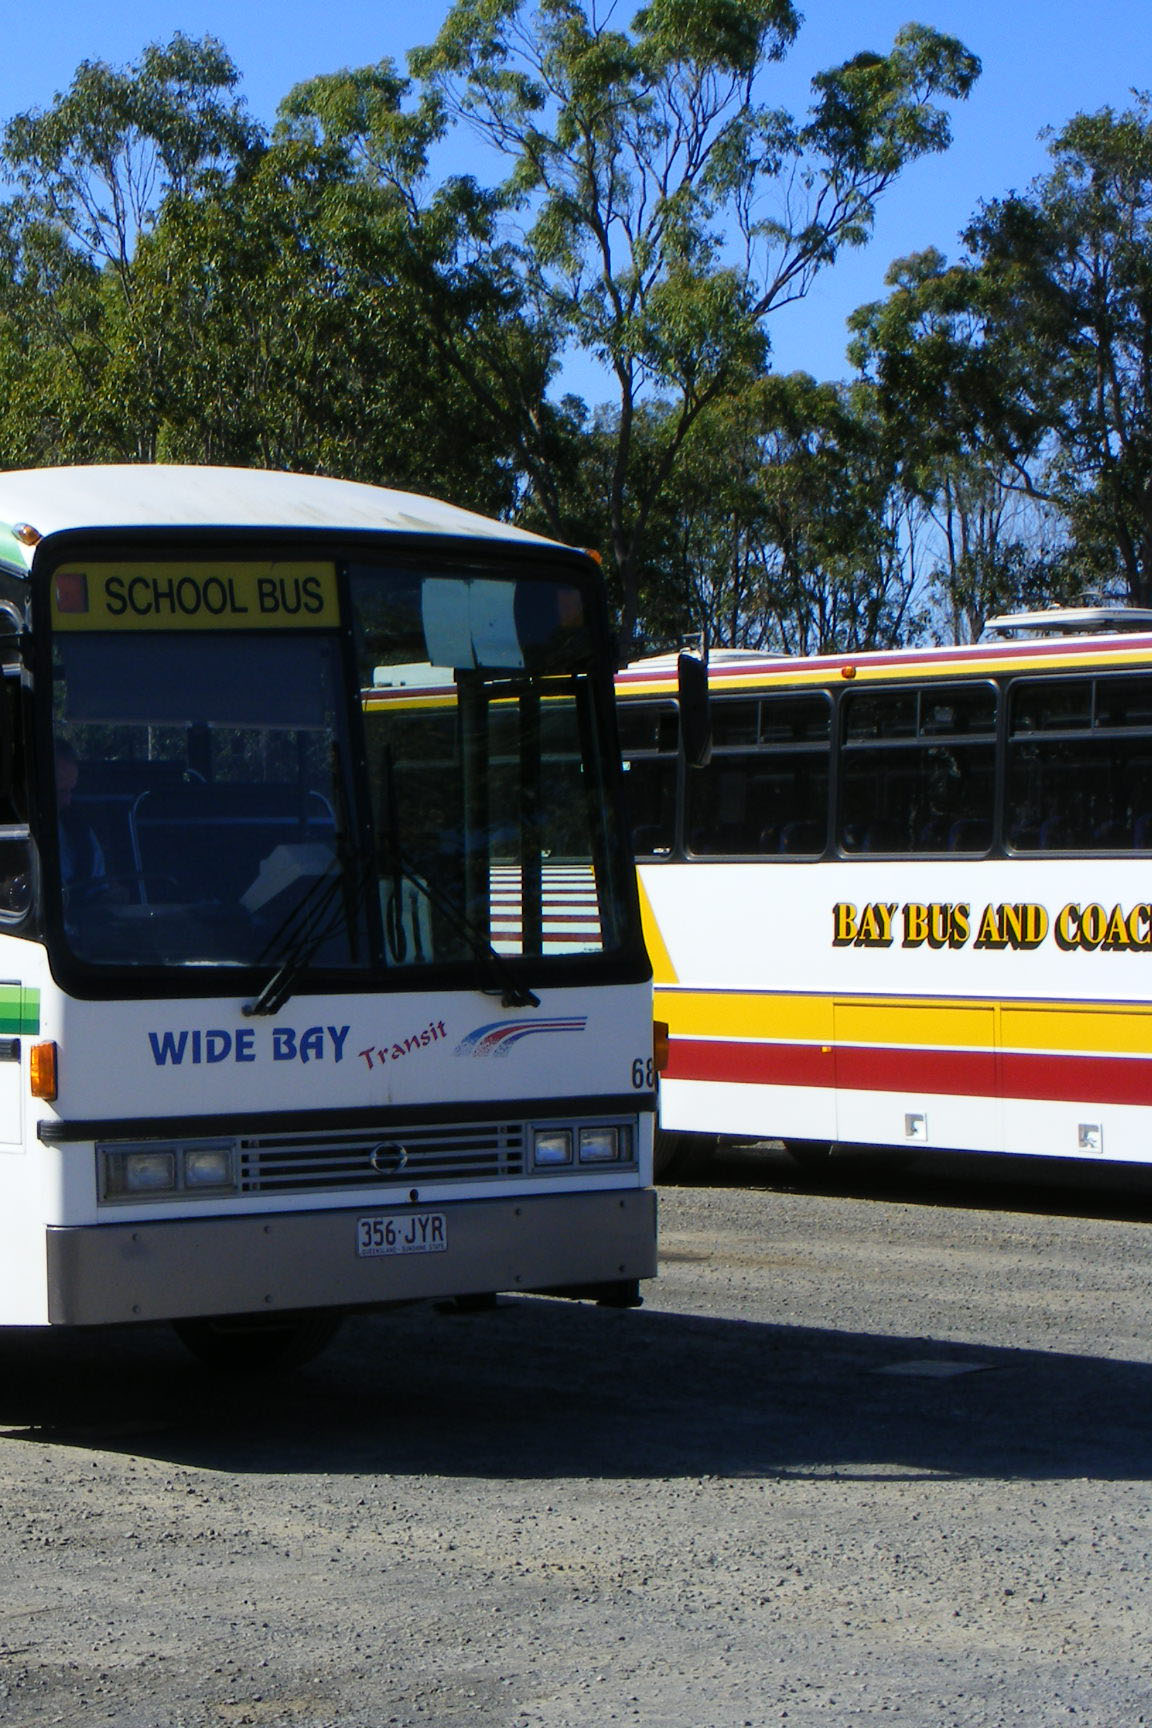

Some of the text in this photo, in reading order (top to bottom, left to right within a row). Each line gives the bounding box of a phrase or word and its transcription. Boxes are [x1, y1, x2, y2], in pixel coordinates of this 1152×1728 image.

[104, 576, 325, 615] SCHOOL BUS
[832, 902, 898, 948] BAY
[901, 902, 970, 949] BUS
[973, 902, 1049, 950] AND
[148, 1019, 448, 1071] WIDE BAY Transit
